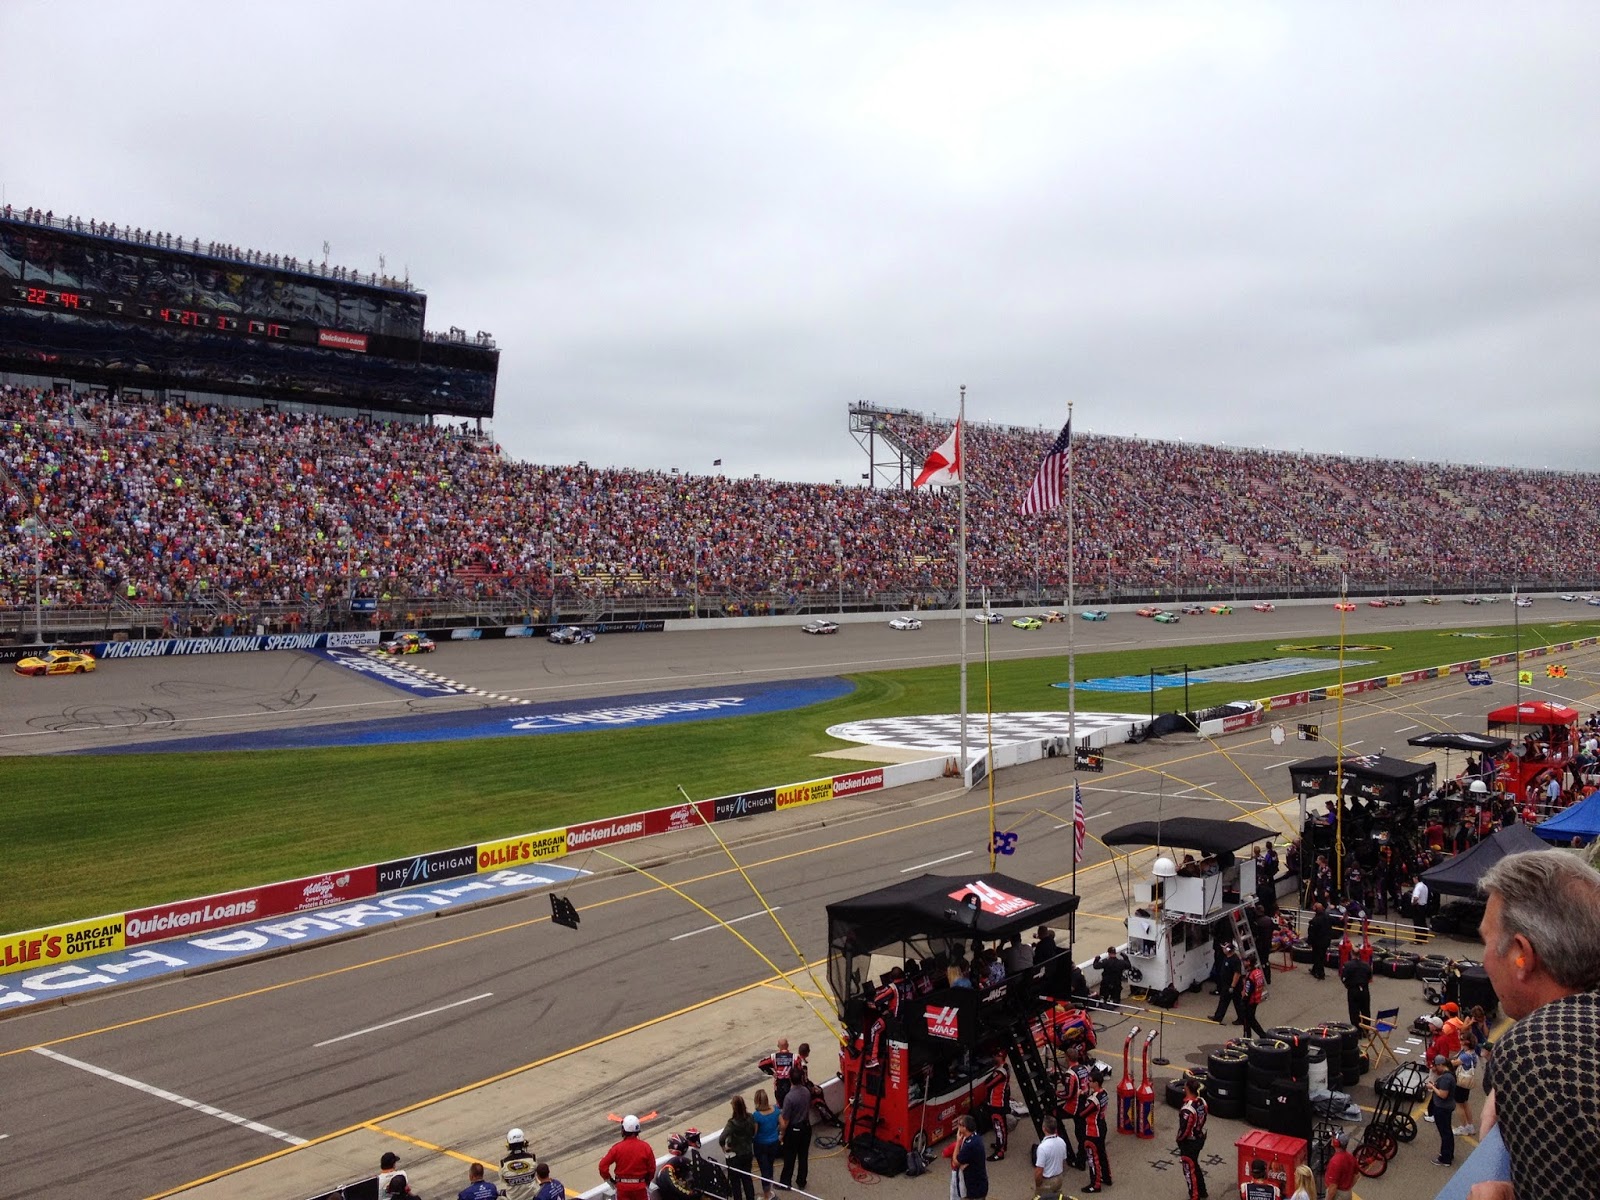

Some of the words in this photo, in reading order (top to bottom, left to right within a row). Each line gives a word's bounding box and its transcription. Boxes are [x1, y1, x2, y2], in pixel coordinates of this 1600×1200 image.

[28, 288, 47, 304] 22
[61, 293, 79, 308] 99
[160, 309, 169, 321] 4
[181, 311, 198, 325] 27
[217, 316, 226, 329] 3
[320, 333, 346, 343] Quicken
[346, 337, 365, 346] Loans
[102, 640, 170, 658] MICHIGAN
[172, 635, 261, 655] INTERNATIONAL
[264, 633, 320, 651] SPEEDWAY
[1077, 756, 1097, 764] FedEx
[811, 784, 832, 793] BARGAIN
[833, 777, 861, 793] Quicken
[861, 773, 883, 786] Loans
[1301, 780, 1320, 789] FedEx
[1361, 784, 1381, 794] FedEx
[811, 791, 829, 800] OUTLET
[716, 804, 734, 813] PURE
[729, 796, 774, 818] MICHIGAN
[566, 828, 612, 847] Quicken
[611, 820, 644, 836] Loans
[533, 834, 565, 849] BARGAIN
[533, 845, 560, 857] OUTLET
[380, 867, 407, 882] PURE
[400, 856, 474, 887] MICHIGAN
[303, 881, 335, 896] Kellogg's
[299, 901, 318, 910] Protein
[126, 908, 202, 938] Quicken
[203, 899, 257, 922] Loans
[66, 923, 122, 944] BARGAIN
[0, 934, 62, 968] LIE'S
[66, 936, 114, 955] OUTLET
[928, 1024, 958, 1036] HAAS
[1277, 1095, 1287, 1104] 41
